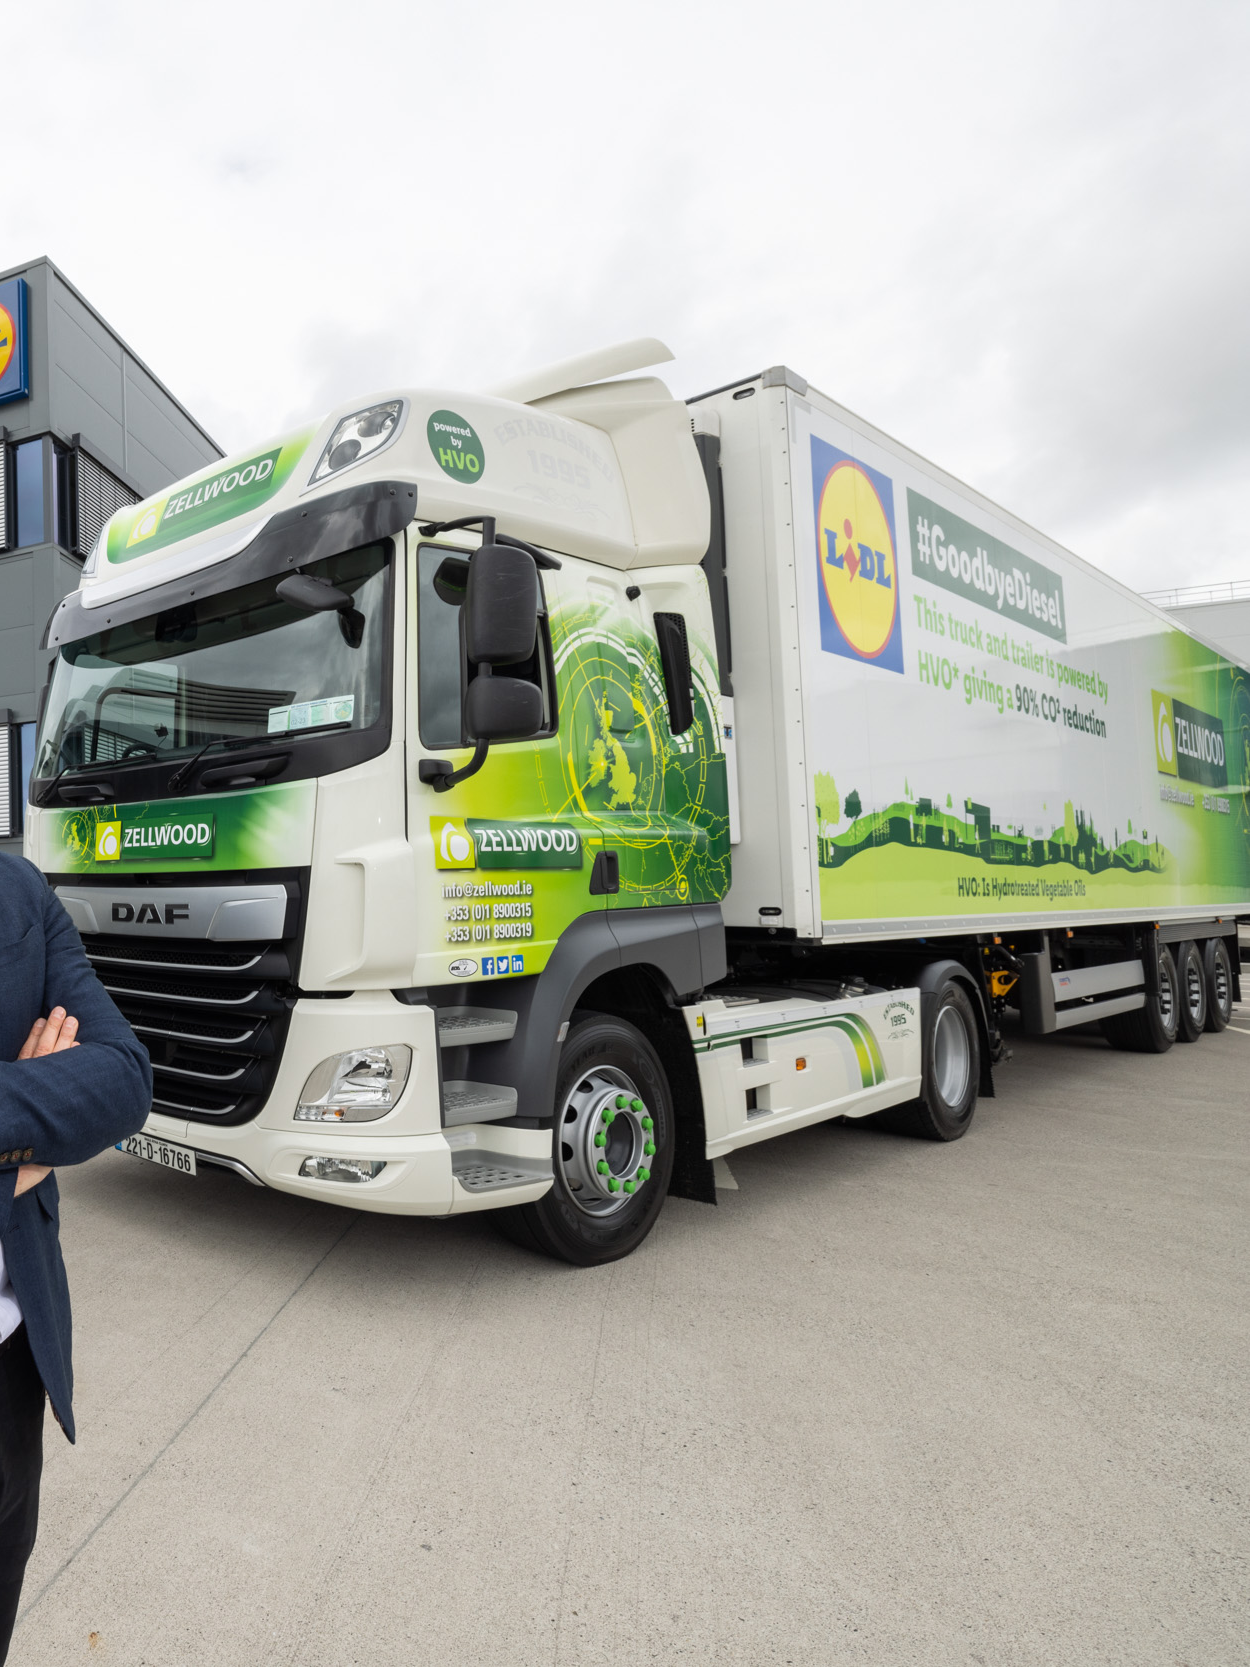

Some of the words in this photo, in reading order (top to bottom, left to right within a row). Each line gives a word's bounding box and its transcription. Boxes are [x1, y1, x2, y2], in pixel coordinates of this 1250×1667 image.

[433, 421, 472, 438] powered
[450, 435, 462, 449] by
[438, 447, 480, 473] HVO
[493, 418, 615, 483] ESTABLISHED
[527, 449, 591, 490] 1995
[163, 458, 274, 520] ZELLWOOD
[916, 515, 1063, 630] #GoodbyeDiesel
[913, 593, 945, 637] This
[948, 611, 984, 652] truck
[986, 631, 1010, 662] and
[1011, 638, 1044, 677] trailer
[1045, 649, 1056, 680] is
[1056, 661, 1097, 697] powered
[1097, 672, 1109, 706] by
[963, 666, 1004, 715] giving
[1006, 686, 1014, 711] a
[1015, 683, 1040, 718] 90%
[1062, 703, 1107, 739] reduction
[1175, 716, 1225, 767] ZELLWOOD
[123, 823, 211, 848] ZELLWOOD
[473, 828, 579, 854] ZELLWOOD
[441, 880, 533, 899] info@zellwood.ie
[957, 876, 981, 897] HVO:
[981, 877, 990, 897] Is
[991, 877, 1040, 901] Hydrotreated
[1040, 879, 1073, 902] Vegetable
[1073, 879, 1086, 896] Oils
[111, 902, 190, 925] DAF
[444, 905, 469, 921] +353
[471, 903, 490, 921] (0)1
[493, 902, 532, 919] 8900315
[444, 926, 470, 943] +353
[472, 924, 491, 942] (0)1
[493, 922, 533, 939] 8900319
[891, 1014, 906, 1027] 1995
[126, 1137, 191, 1172] 221-D-16766
